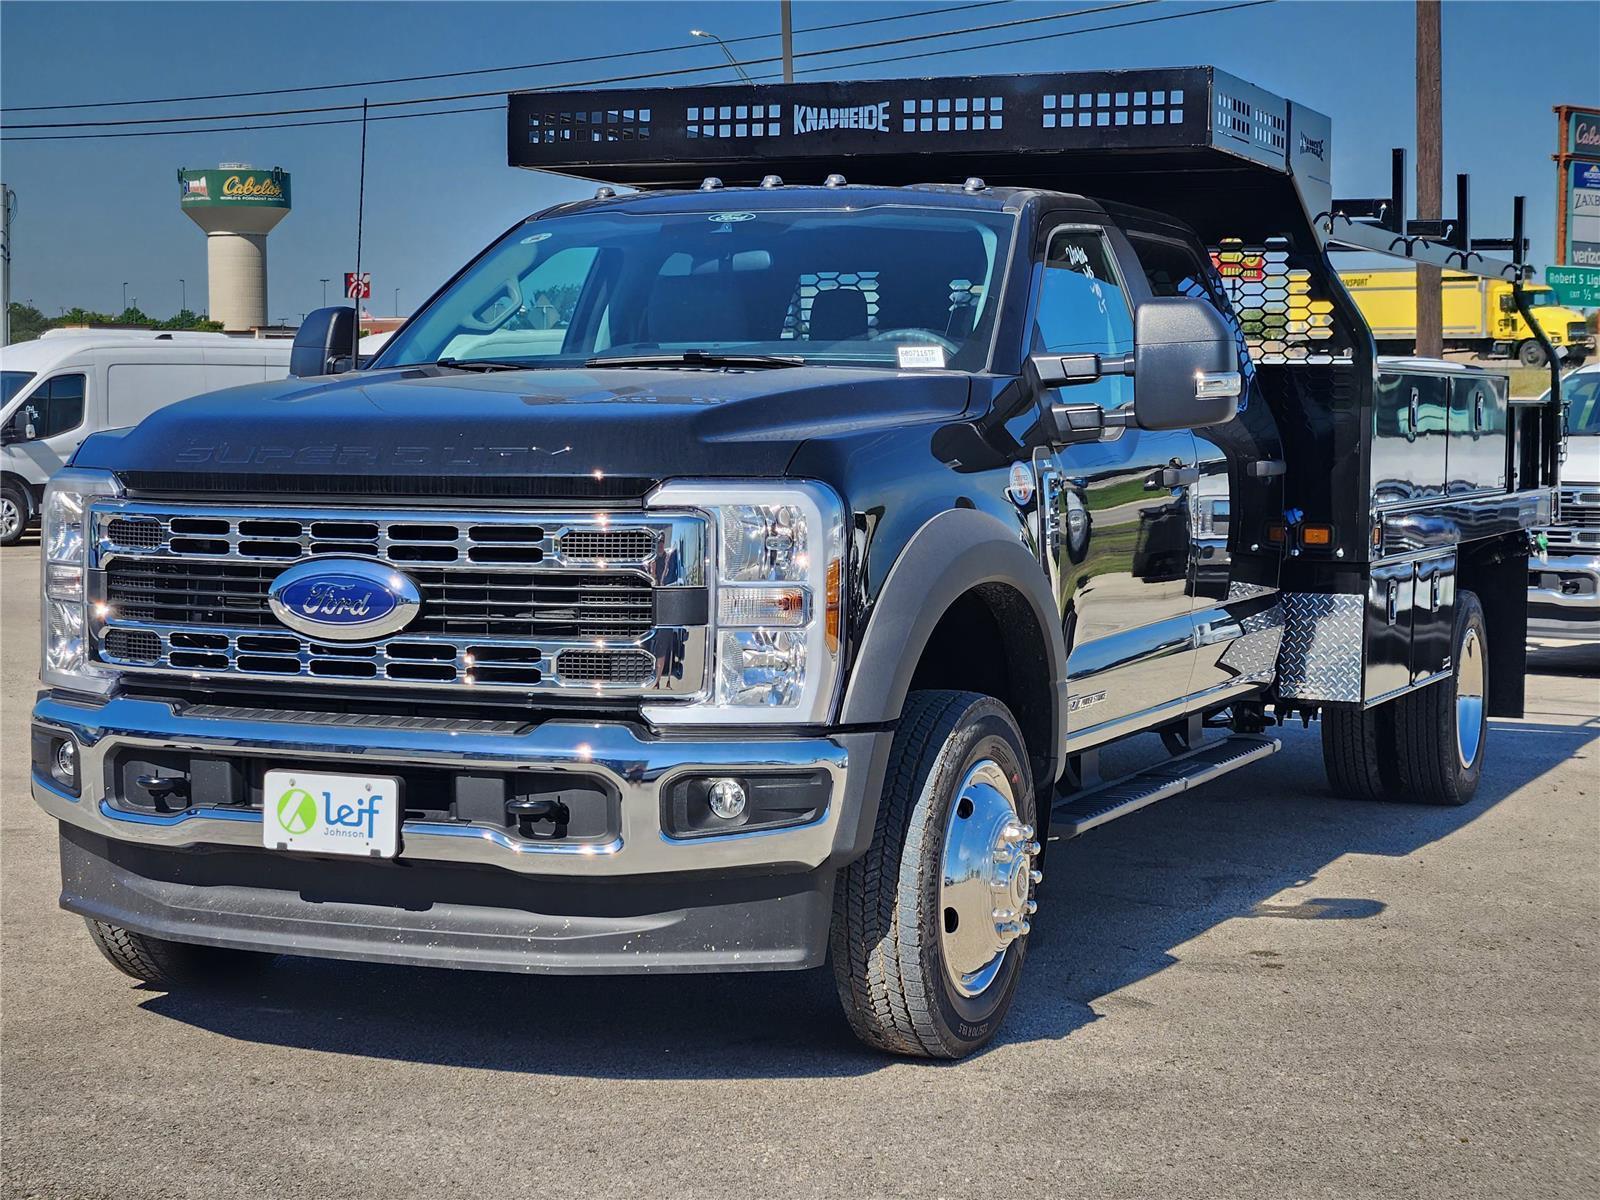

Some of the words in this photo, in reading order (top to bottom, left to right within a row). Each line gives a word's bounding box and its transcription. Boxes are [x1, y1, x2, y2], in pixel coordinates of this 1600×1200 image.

[793, 101, 890, 135] KNAPHEIDE
[1549, 272, 1577, 284] Robert
[1579, 273, 1585, 285] S
[174, 444, 378, 465] SUPER
[392, 445, 574, 466] DUTY
[302, 581, 373, 617] Ford
[322, 791, 383, 839] leif
[323, 827, 365, 838] Johnson
